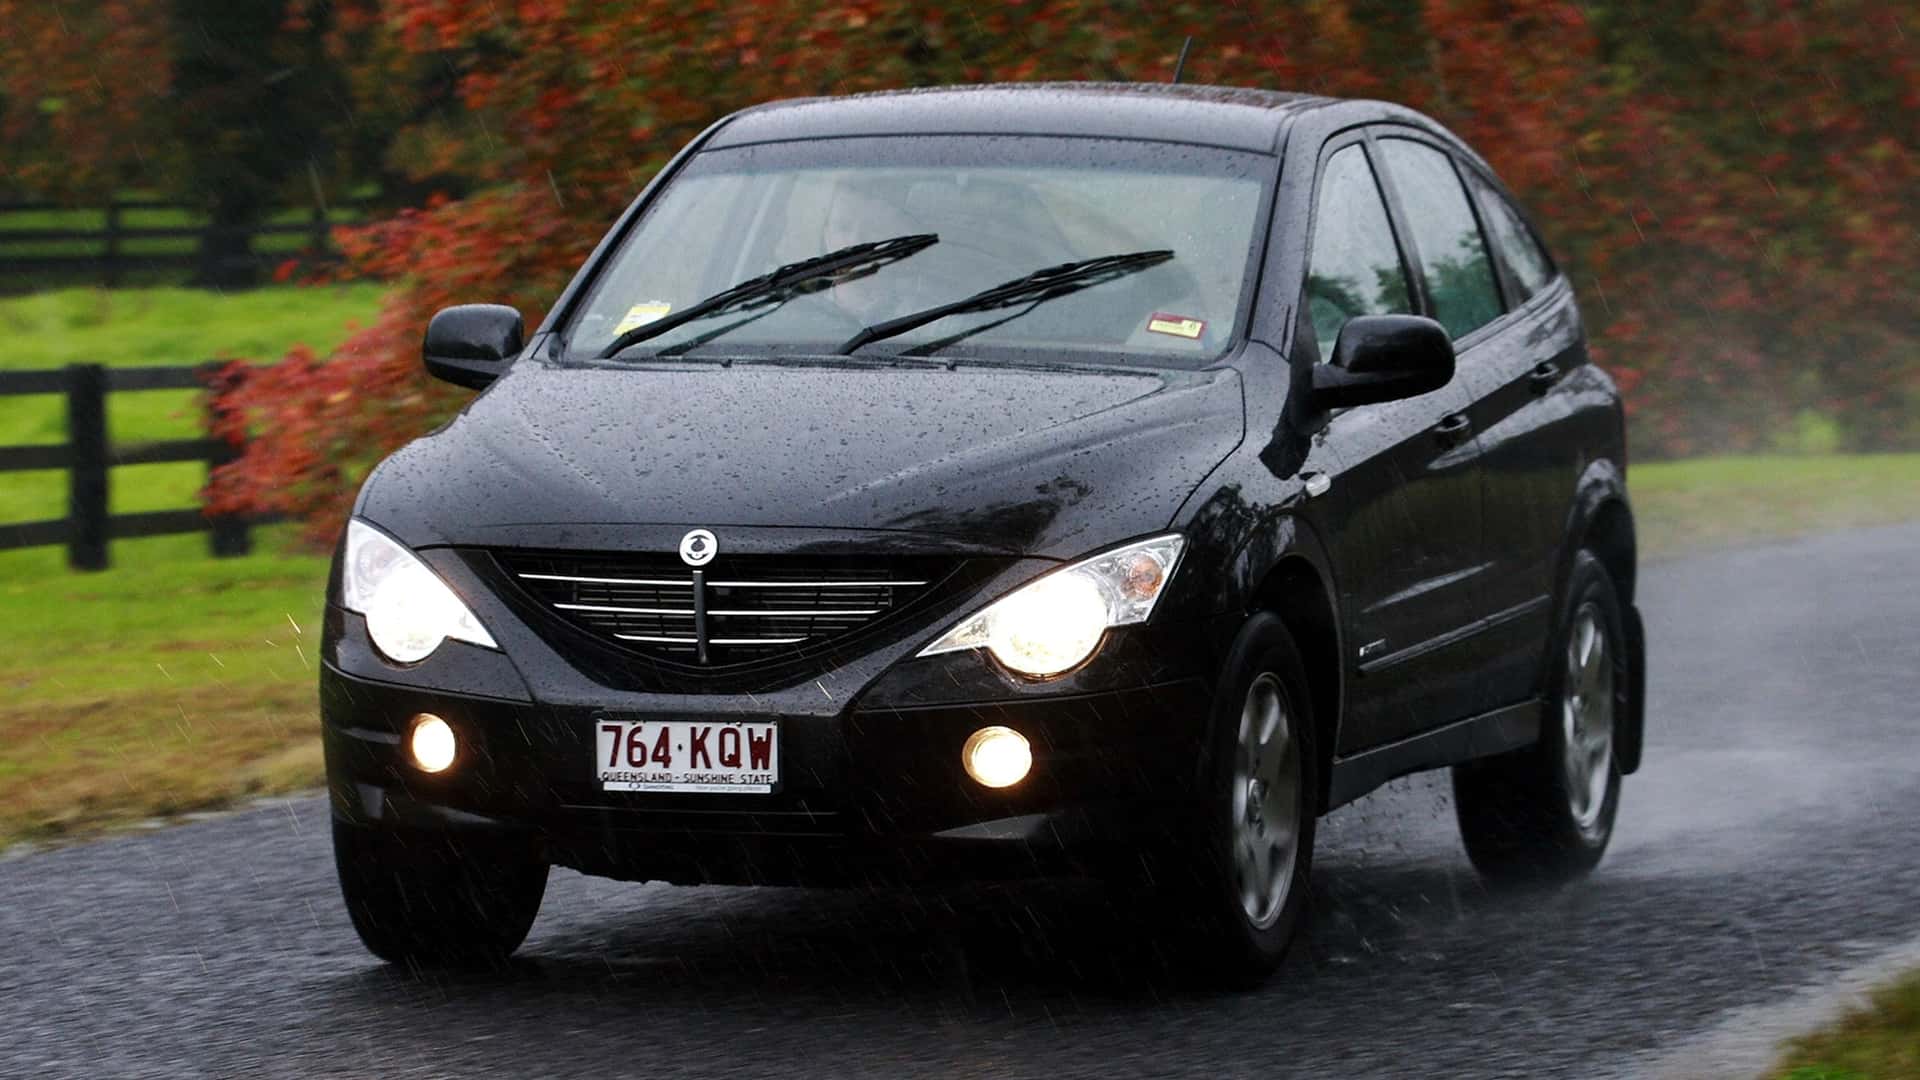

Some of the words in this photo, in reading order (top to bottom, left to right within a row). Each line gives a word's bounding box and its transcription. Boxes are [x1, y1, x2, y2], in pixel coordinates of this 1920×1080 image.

[602, 771, 672, 782] QUEENSLAND
[685, 773, 734, 783] SUNSHINE
[740, 774, 772, 784] STATE
